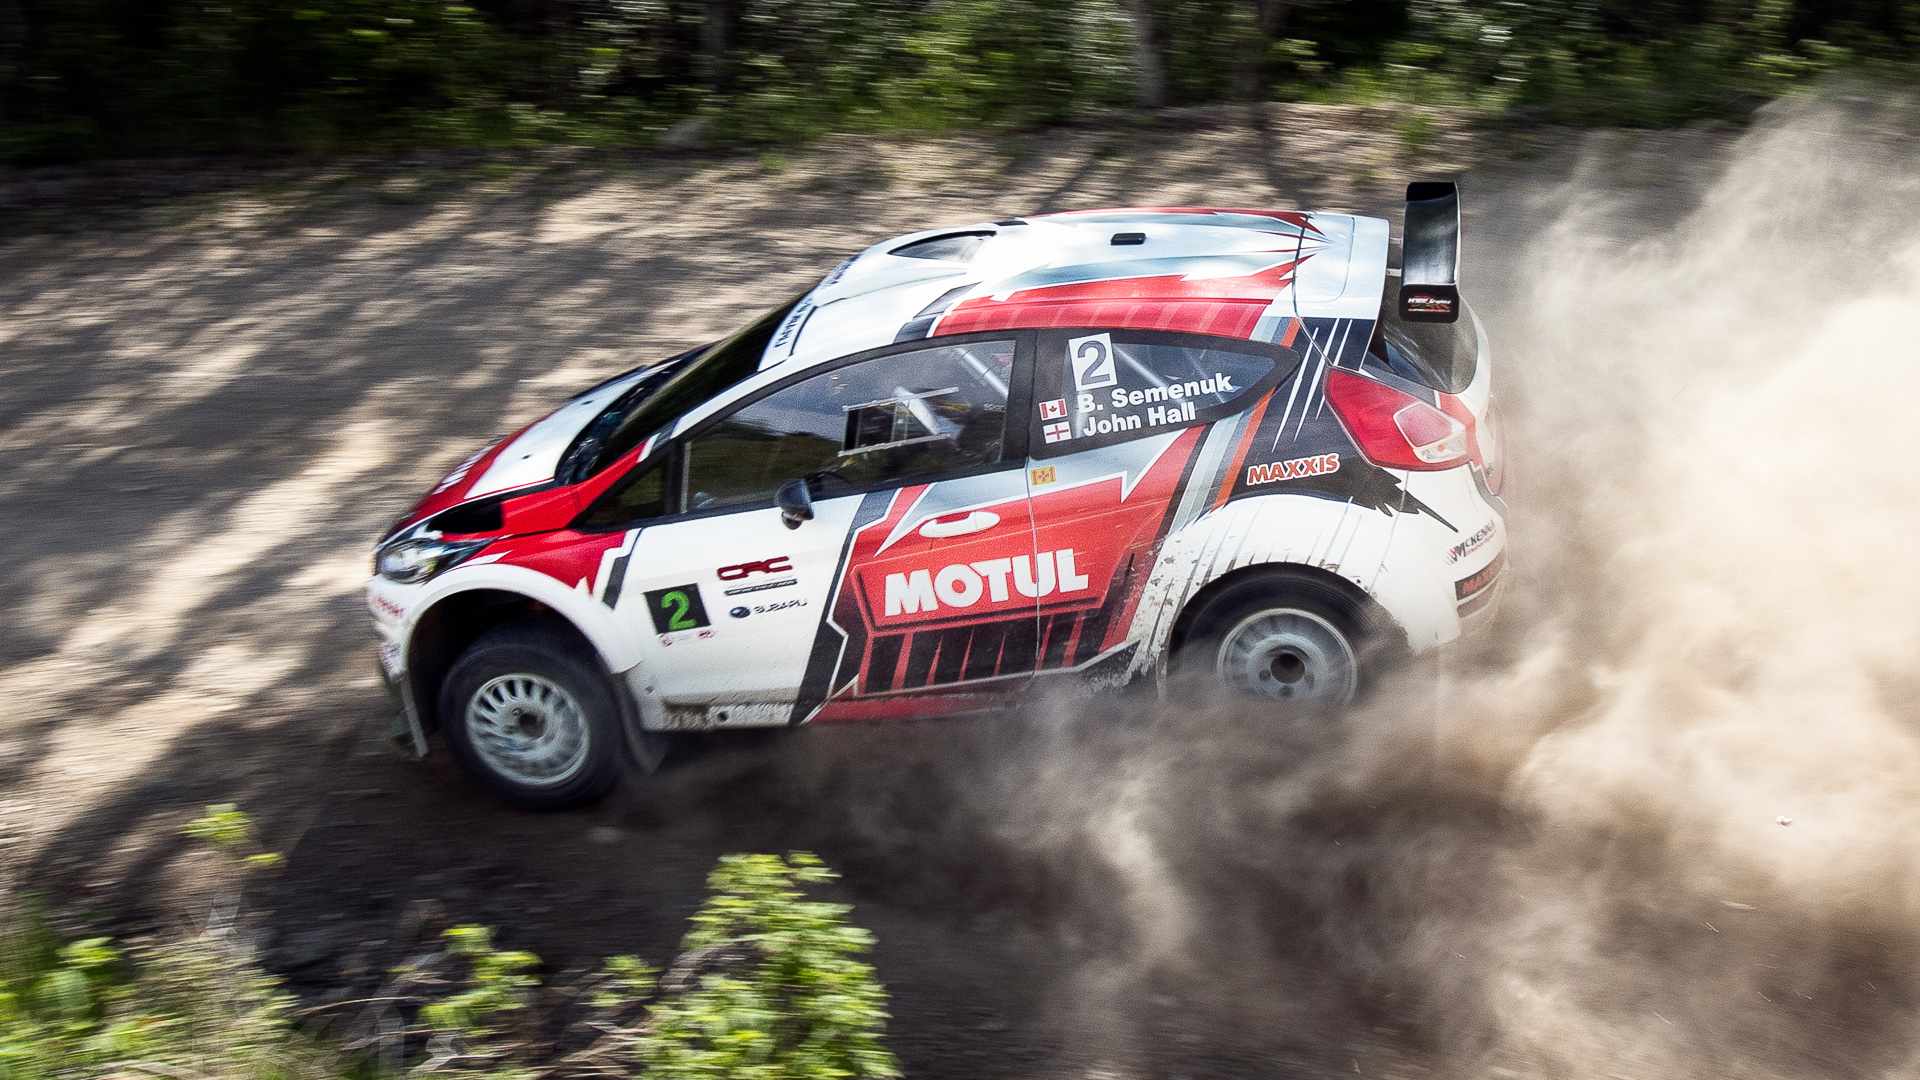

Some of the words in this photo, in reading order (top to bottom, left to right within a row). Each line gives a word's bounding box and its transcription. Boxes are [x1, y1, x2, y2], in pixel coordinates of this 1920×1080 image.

[1076, 340, 1111, 387] 2
[1076, 393, 1103, 413] B.
[1111, 372, 1234, 408] Semenuk
[1083, 412, 1142, 437] John
[1149, 402, 1196, 427] Hall
[1246, 453, 1340, 486] MAXXIS
[884, 548, 1089, 617] MOTUL
[661, 590, 697, 631] 2
